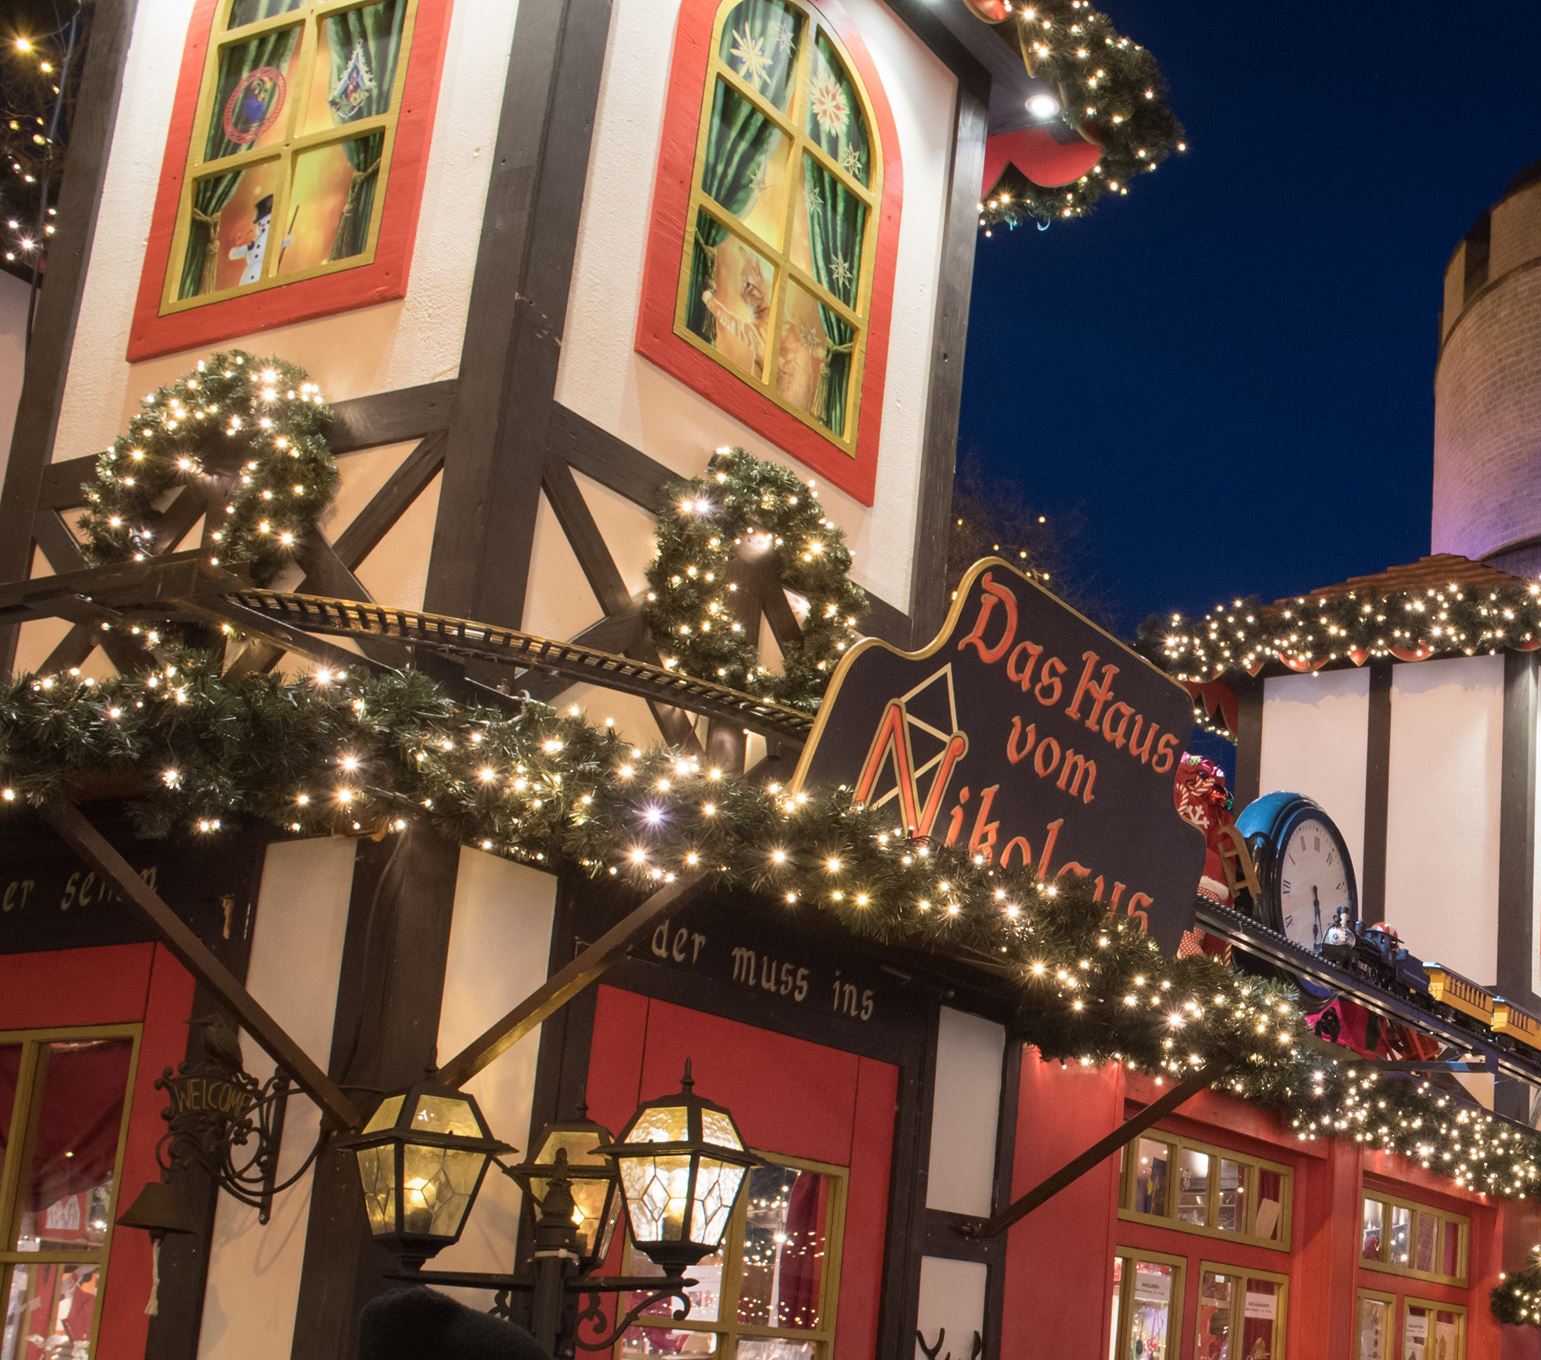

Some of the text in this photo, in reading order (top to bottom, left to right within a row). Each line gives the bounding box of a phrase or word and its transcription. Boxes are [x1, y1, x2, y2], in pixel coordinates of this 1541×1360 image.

[957, 571, 1179, 774] Das Haus
[1006, 715, 1098, 804] vom
[852, 698, 1154, 937] Nikolus
[651, 919, 877, 1021] der muss ins
[174, 1078, 249, 1117] WELCOME
